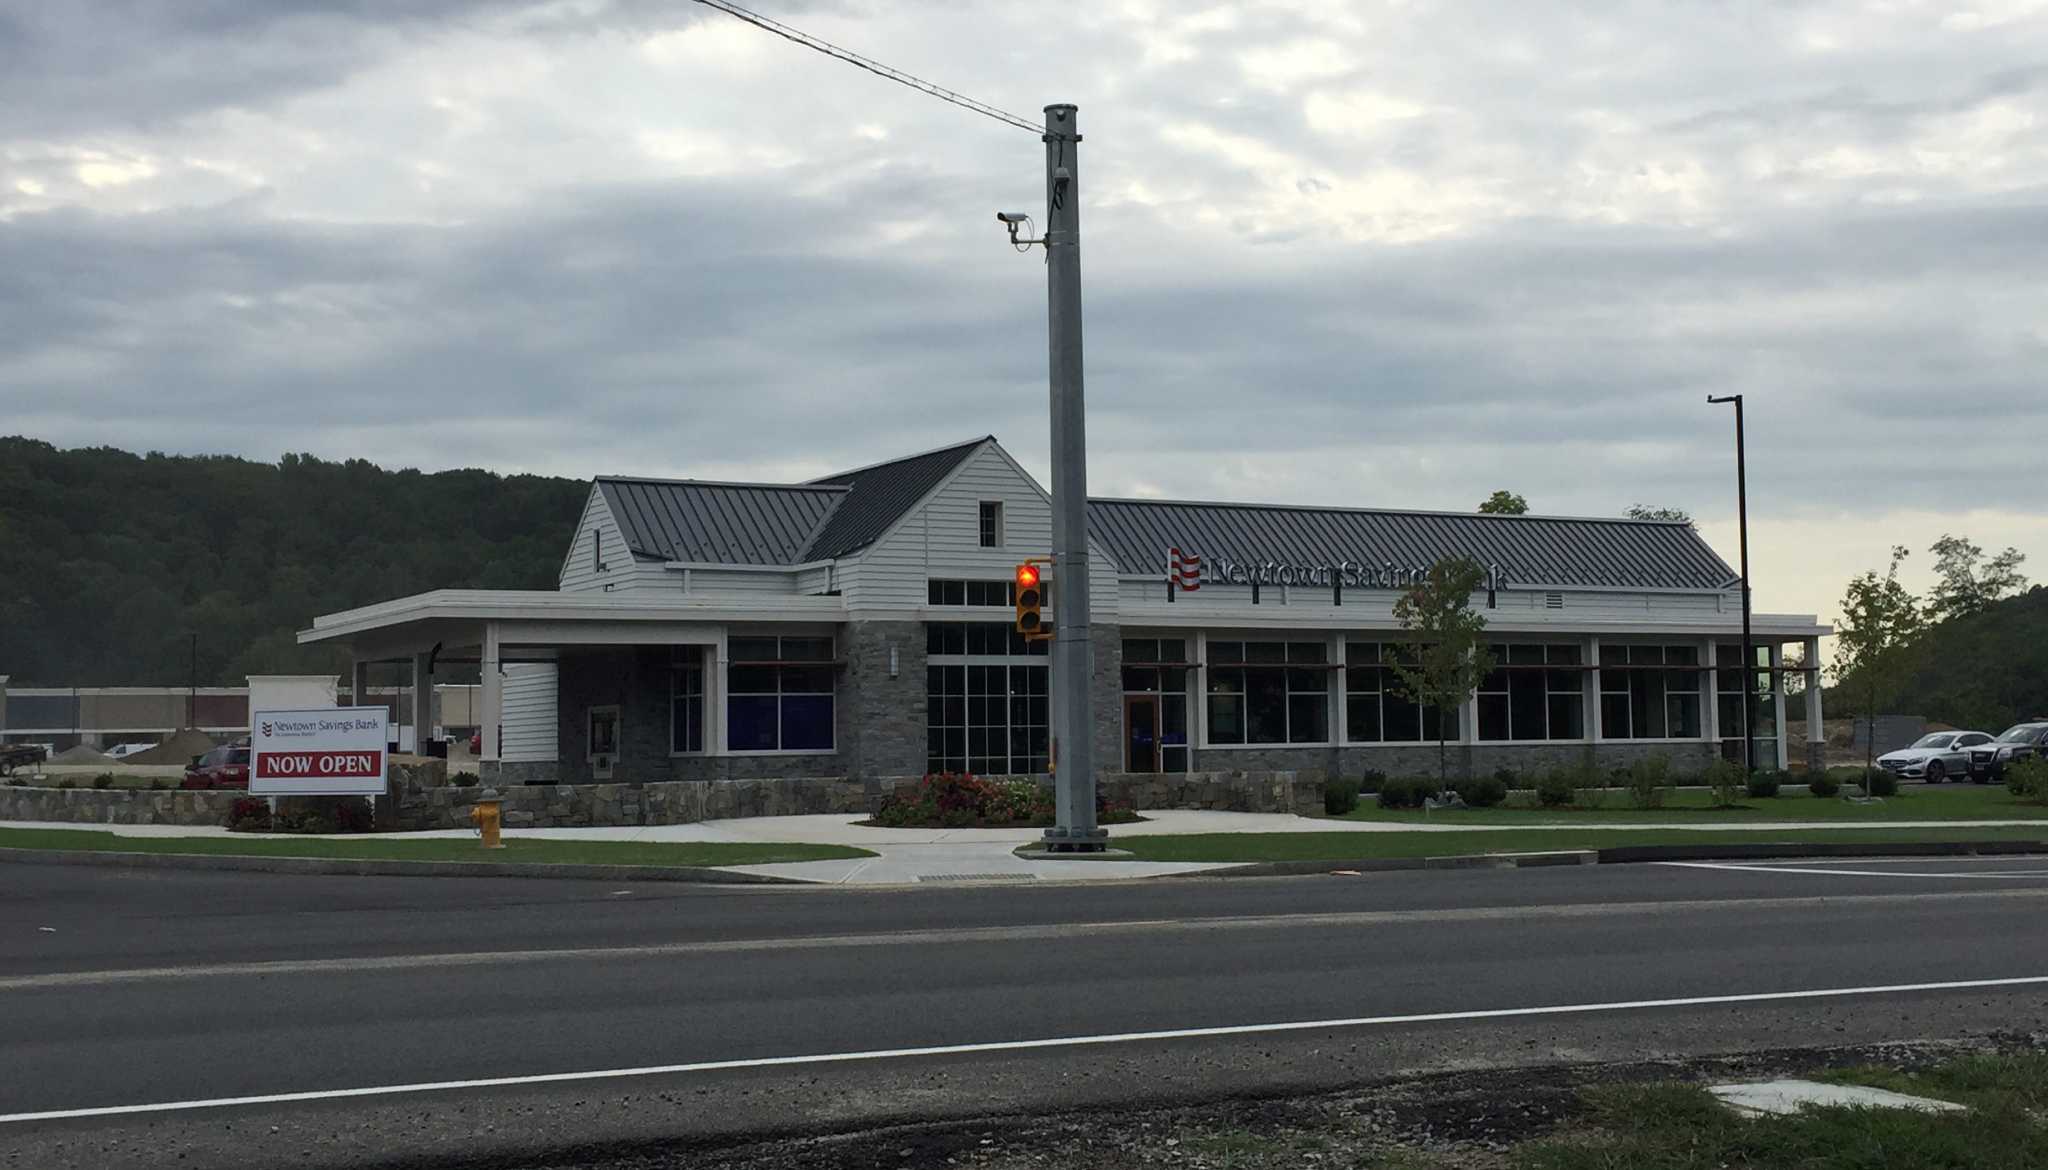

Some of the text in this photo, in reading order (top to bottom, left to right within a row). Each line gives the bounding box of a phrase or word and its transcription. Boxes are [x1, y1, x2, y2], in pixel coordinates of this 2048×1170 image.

[1208, 558, 1335, 586] Newtown
[274, 718, 379, 733] Newtown Savings Bank
[267, 754, 372, 774] NOW OPEN
